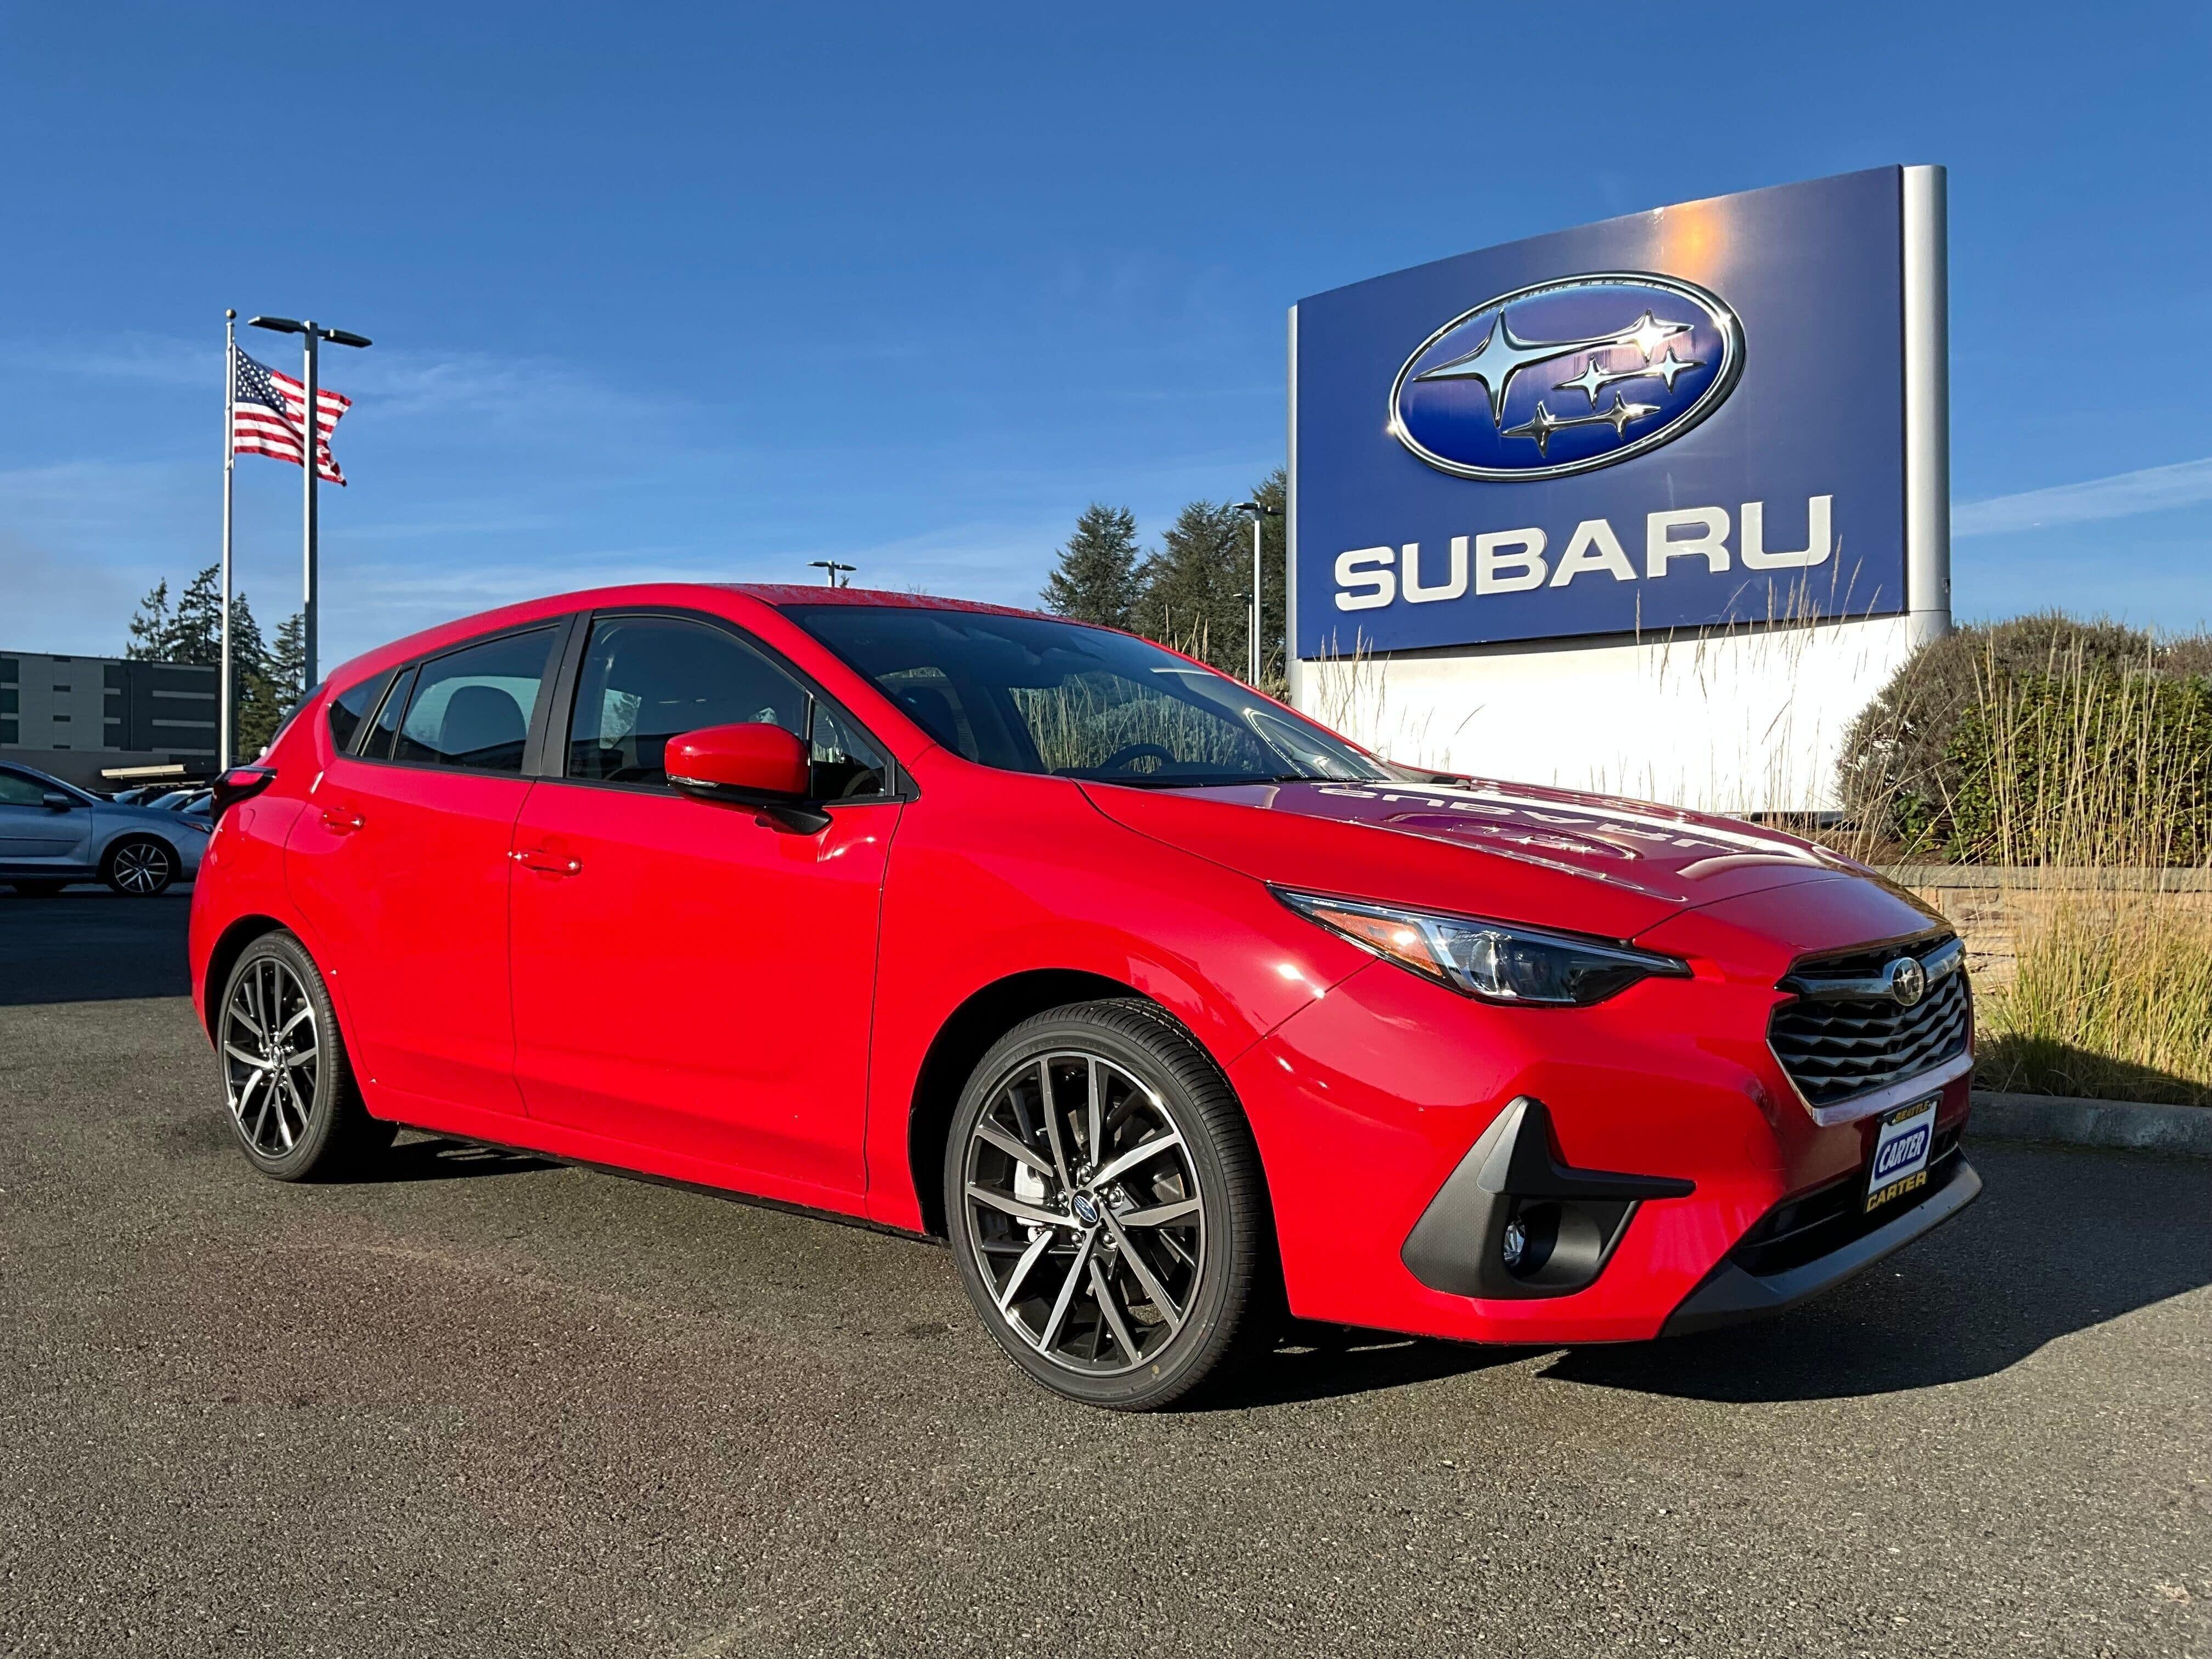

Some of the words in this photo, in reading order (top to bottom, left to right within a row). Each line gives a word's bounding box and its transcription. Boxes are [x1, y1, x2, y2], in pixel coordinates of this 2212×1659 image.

[1335, 495, 1833, 612] SUBARU
[1895, 1101, 1930, 1121] SEATTLE
[1878, 1130, 1926, 1173] CARTER
[1866, 1171, 1927, 1213] CARTER
